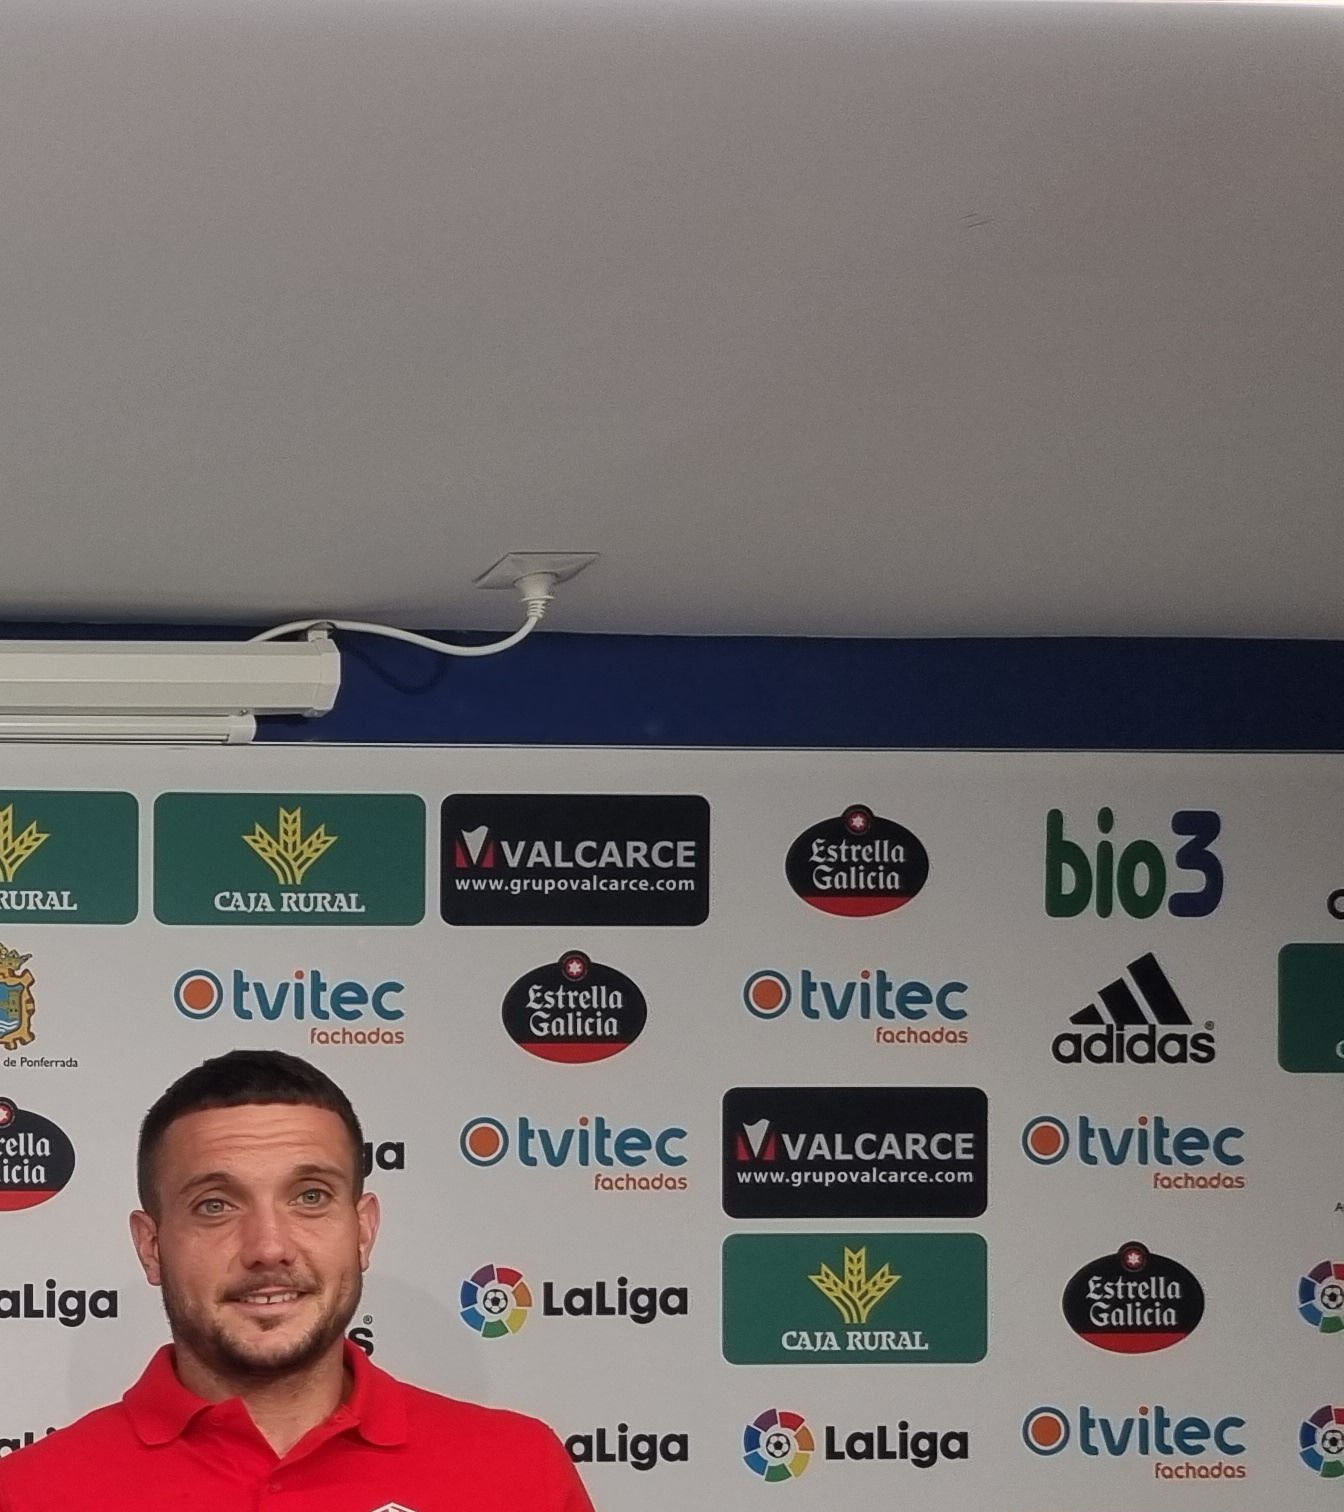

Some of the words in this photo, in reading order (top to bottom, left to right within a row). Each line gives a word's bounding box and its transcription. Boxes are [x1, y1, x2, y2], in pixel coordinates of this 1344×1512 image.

[501, 841, 695, 868] VALCARCE
[810, 839, 904, 863] Estrella
[1046, 807, 1223, 919] bio3
[456, 875, 694, 894] www.grupovalcarce.com
[813, 865, 899, 889] Galicia
[215, 892, 275, 912] CAJA
[281, 893, 365, 912] RURAL
[234, 970, 404, 1020] tvitec
[526, 985, 622, 1009] Estrella
[802, 970, 968, 1020] tvitec
[530, 1011, 618, 1036] Galicia
[1052, 1024, 1215, 1064] adidas
[4, 1057, 16, 1067] de
[21, 1057, 77, 1067] Ponferrada
[519, 1117, 687, 1167] tvitec
[782, 1133, 974, 1160] VALCARCE
[1080, 1116, 1244, 1166] tvitec
[595, 1173, 687, 1190] fachadas
[737, 1167, 973, 1187] www.grupovalcarce.com
[544, 1277, 687, 1324] LaLiga
[1086, 1276, 1181, 1300] Estrella
[1090, 1302, 1176, 1326] Galicia
[782, 1331, 841, 1351] CAJA
[846, 1332, 928, 1350] RURAL
[1080, 1406, 1245, 1456] tvitec
[565, 1423, 689, 1471] aLiga
[826, 1421, 968, 1468] LaLiga
